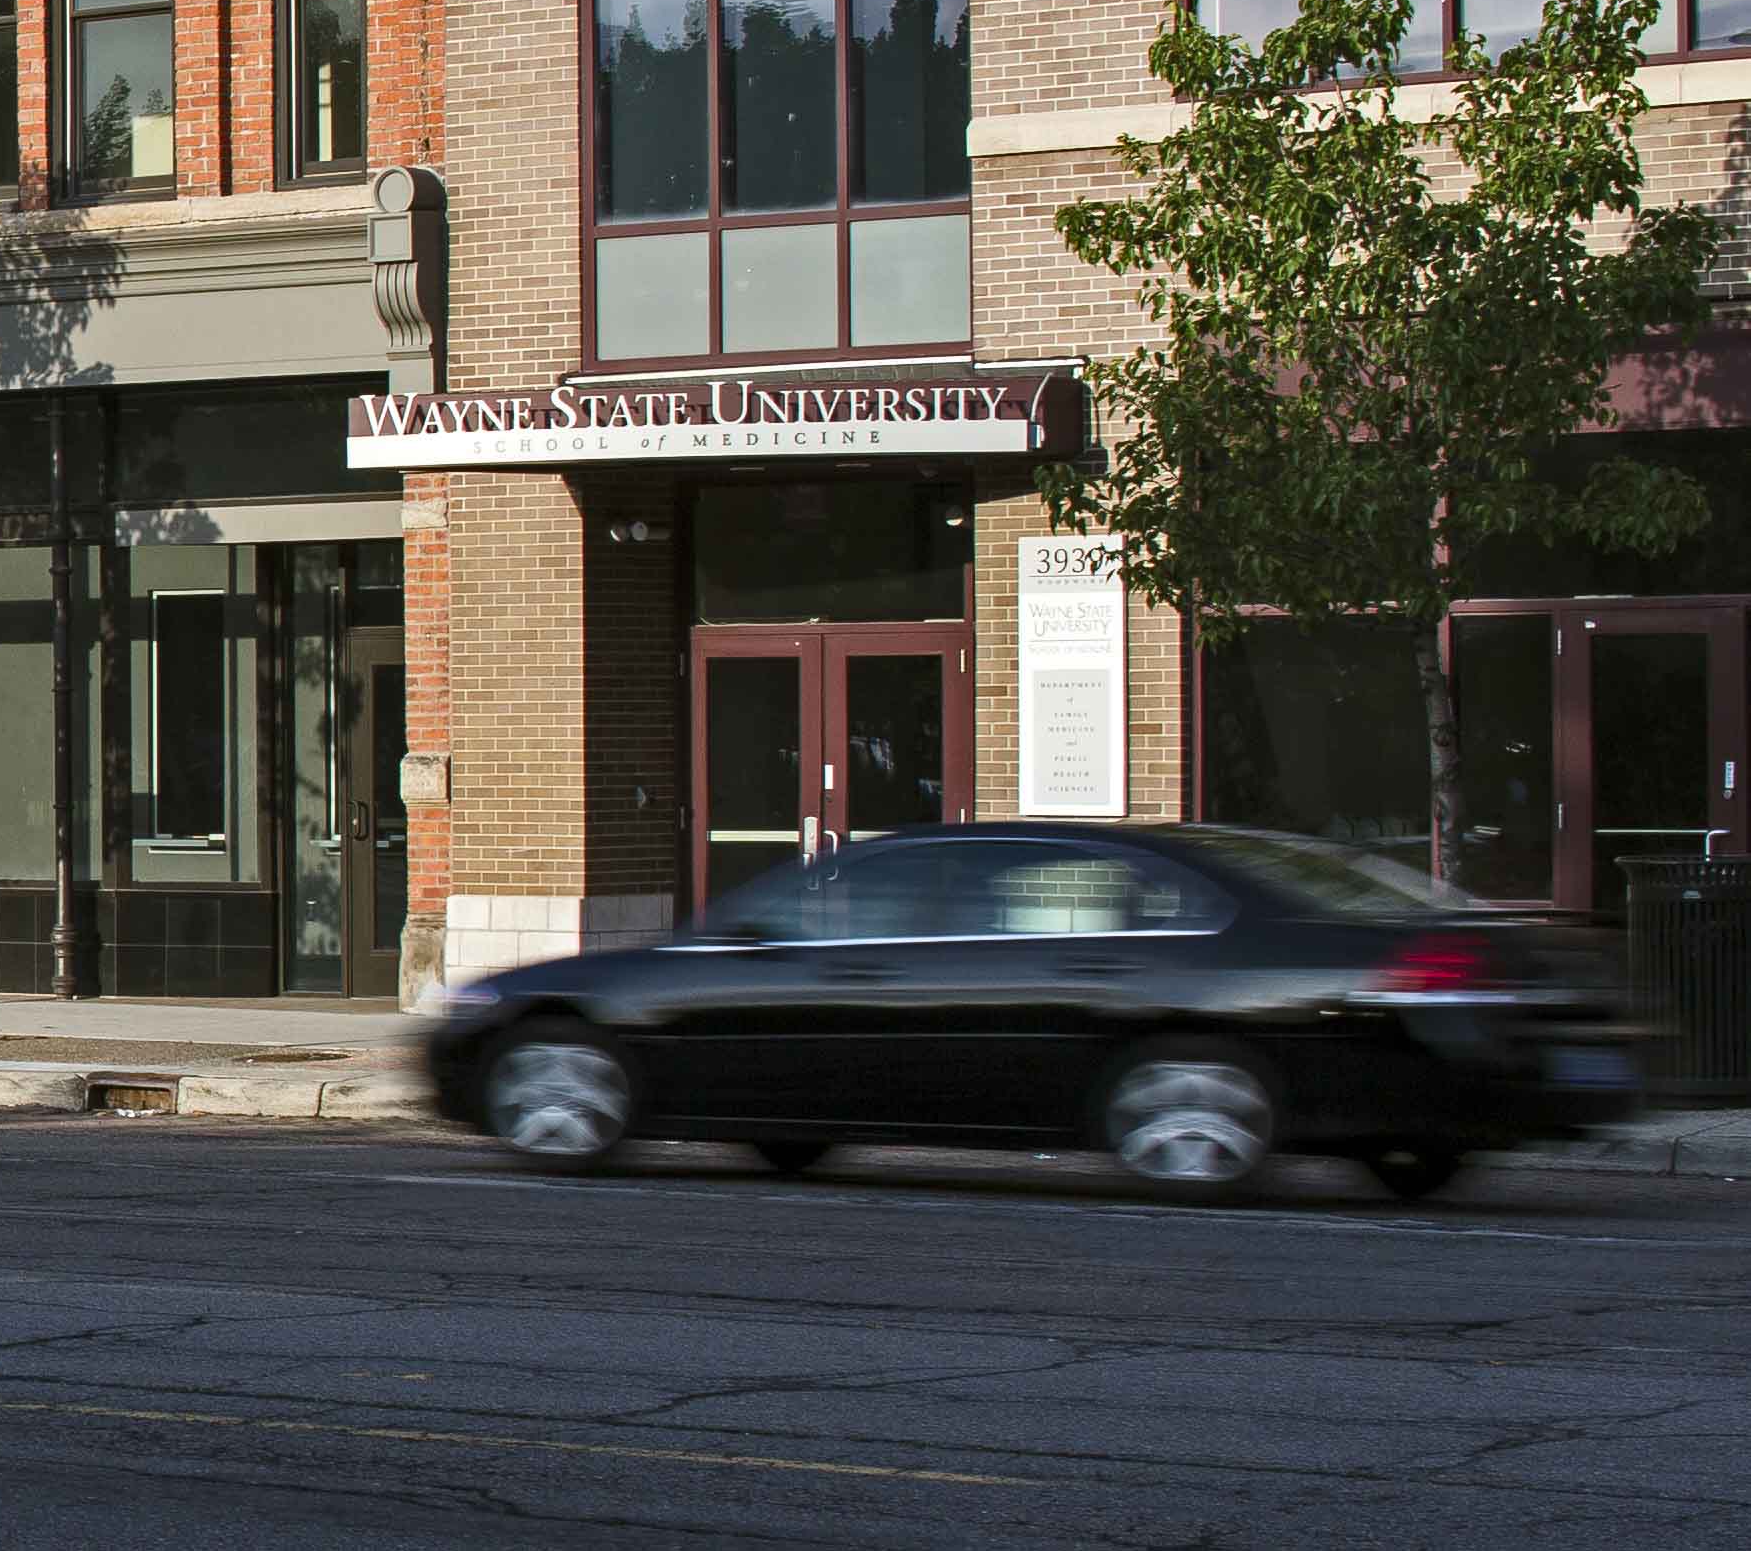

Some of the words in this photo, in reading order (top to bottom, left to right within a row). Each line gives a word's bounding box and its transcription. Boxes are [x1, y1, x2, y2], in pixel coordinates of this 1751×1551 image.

[360, 391, 535, 436] WAYNE
[550, 386, 691, 429] STATE
[706, 380, 1008, 425] UNIVERSITY
[473, 436, 609, 454] SCHOOL
[641, 434, 667, 451] of
[693, 431, 881, 447] MEDICINE
